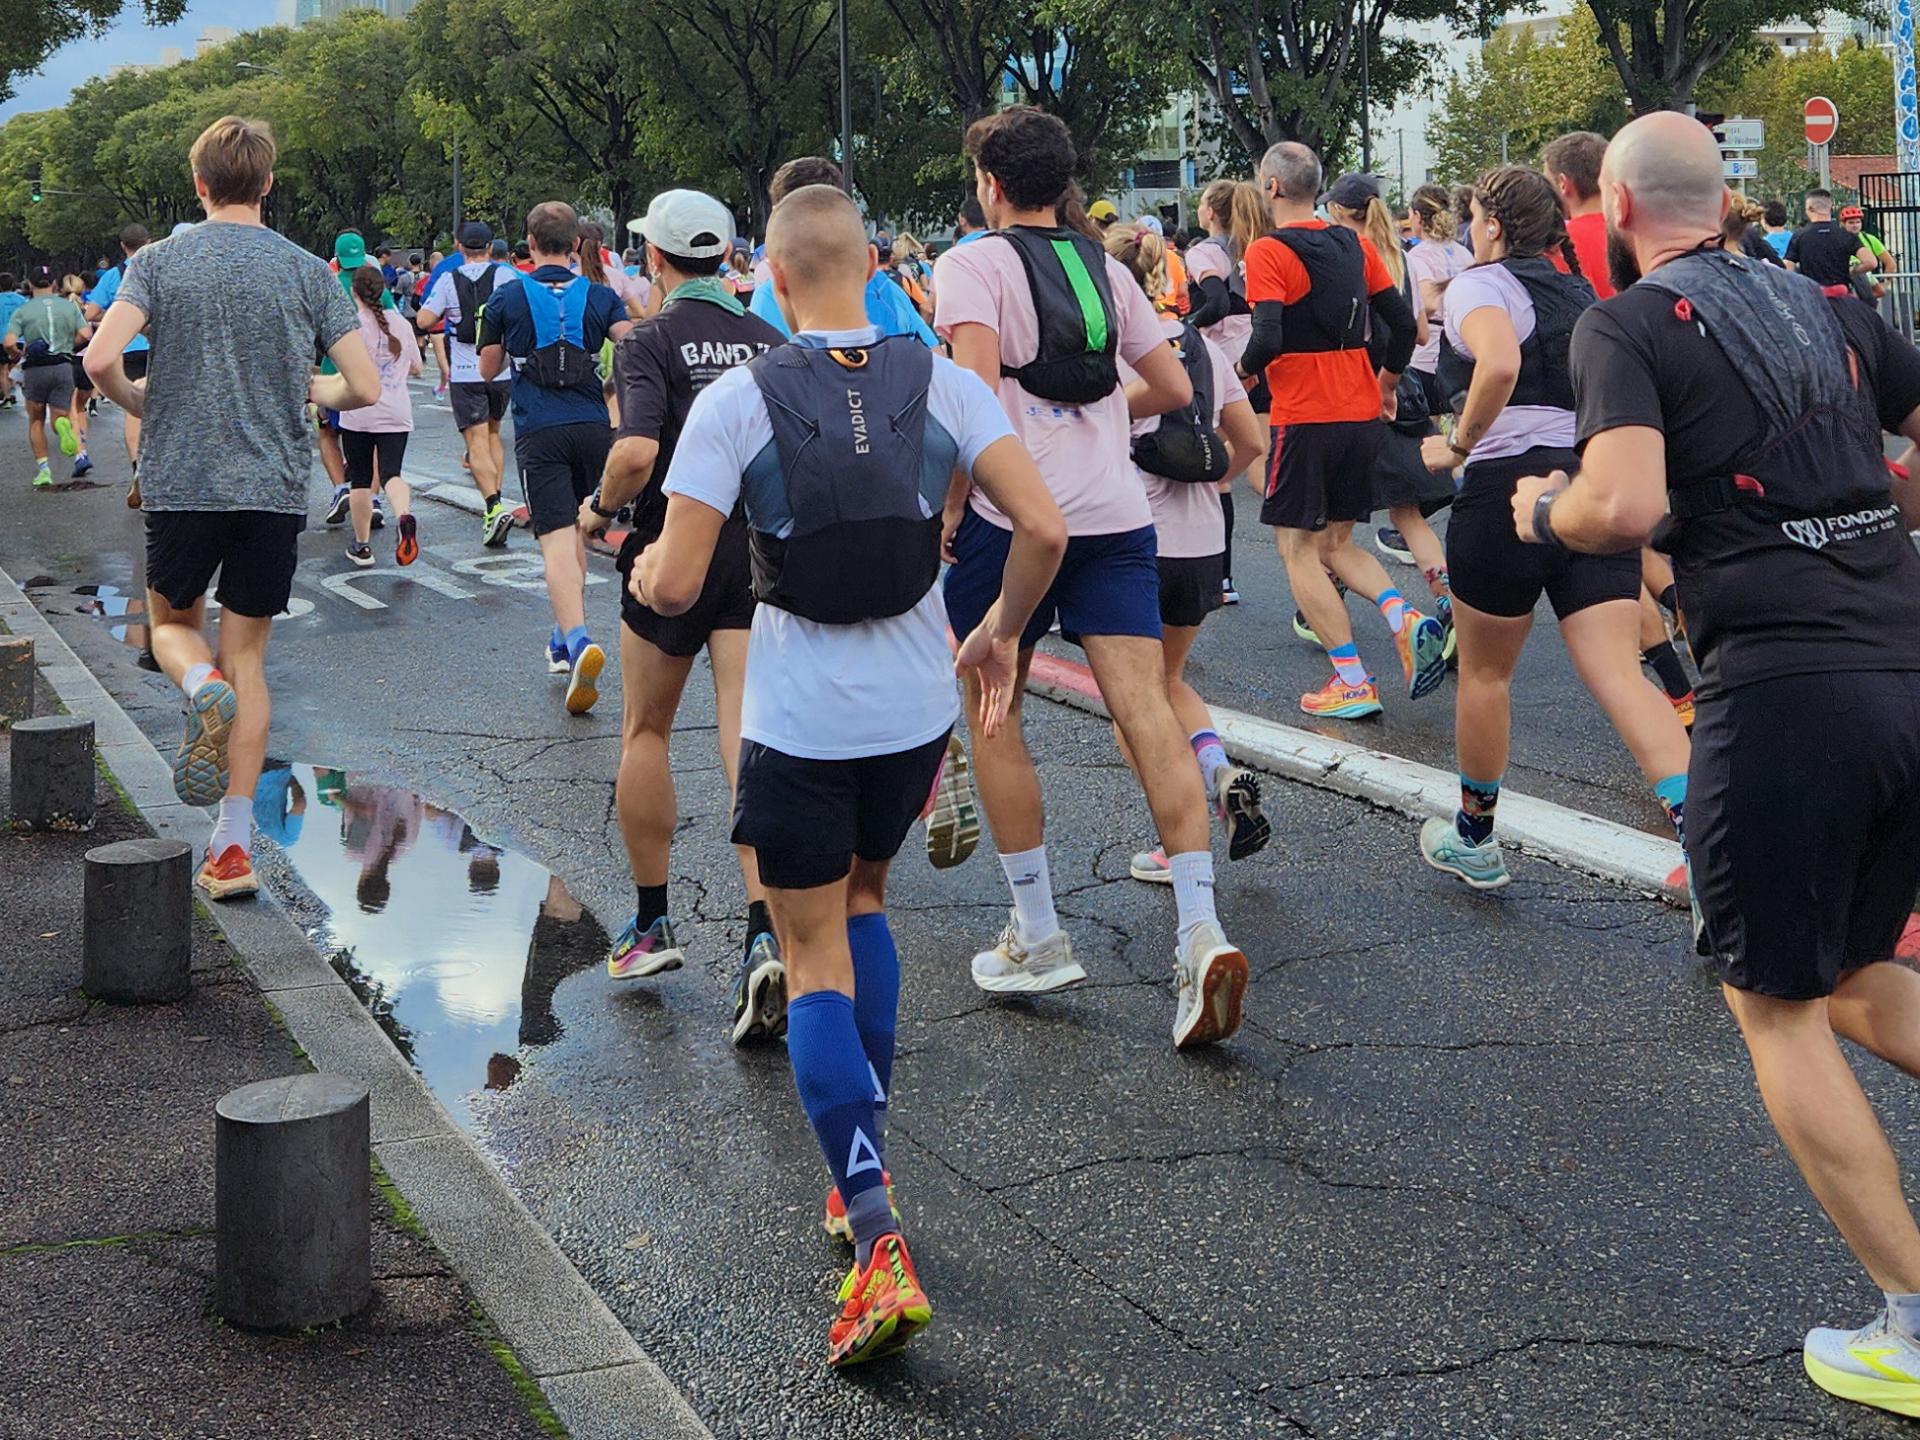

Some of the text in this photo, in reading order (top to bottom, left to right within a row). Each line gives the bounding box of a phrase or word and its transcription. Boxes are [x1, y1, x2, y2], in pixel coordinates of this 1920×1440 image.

[680, 341, 771, 367] BAND
[847, 388, 870, 455] EVADICT
[1200, 433, 1212, 471] EVADICT
